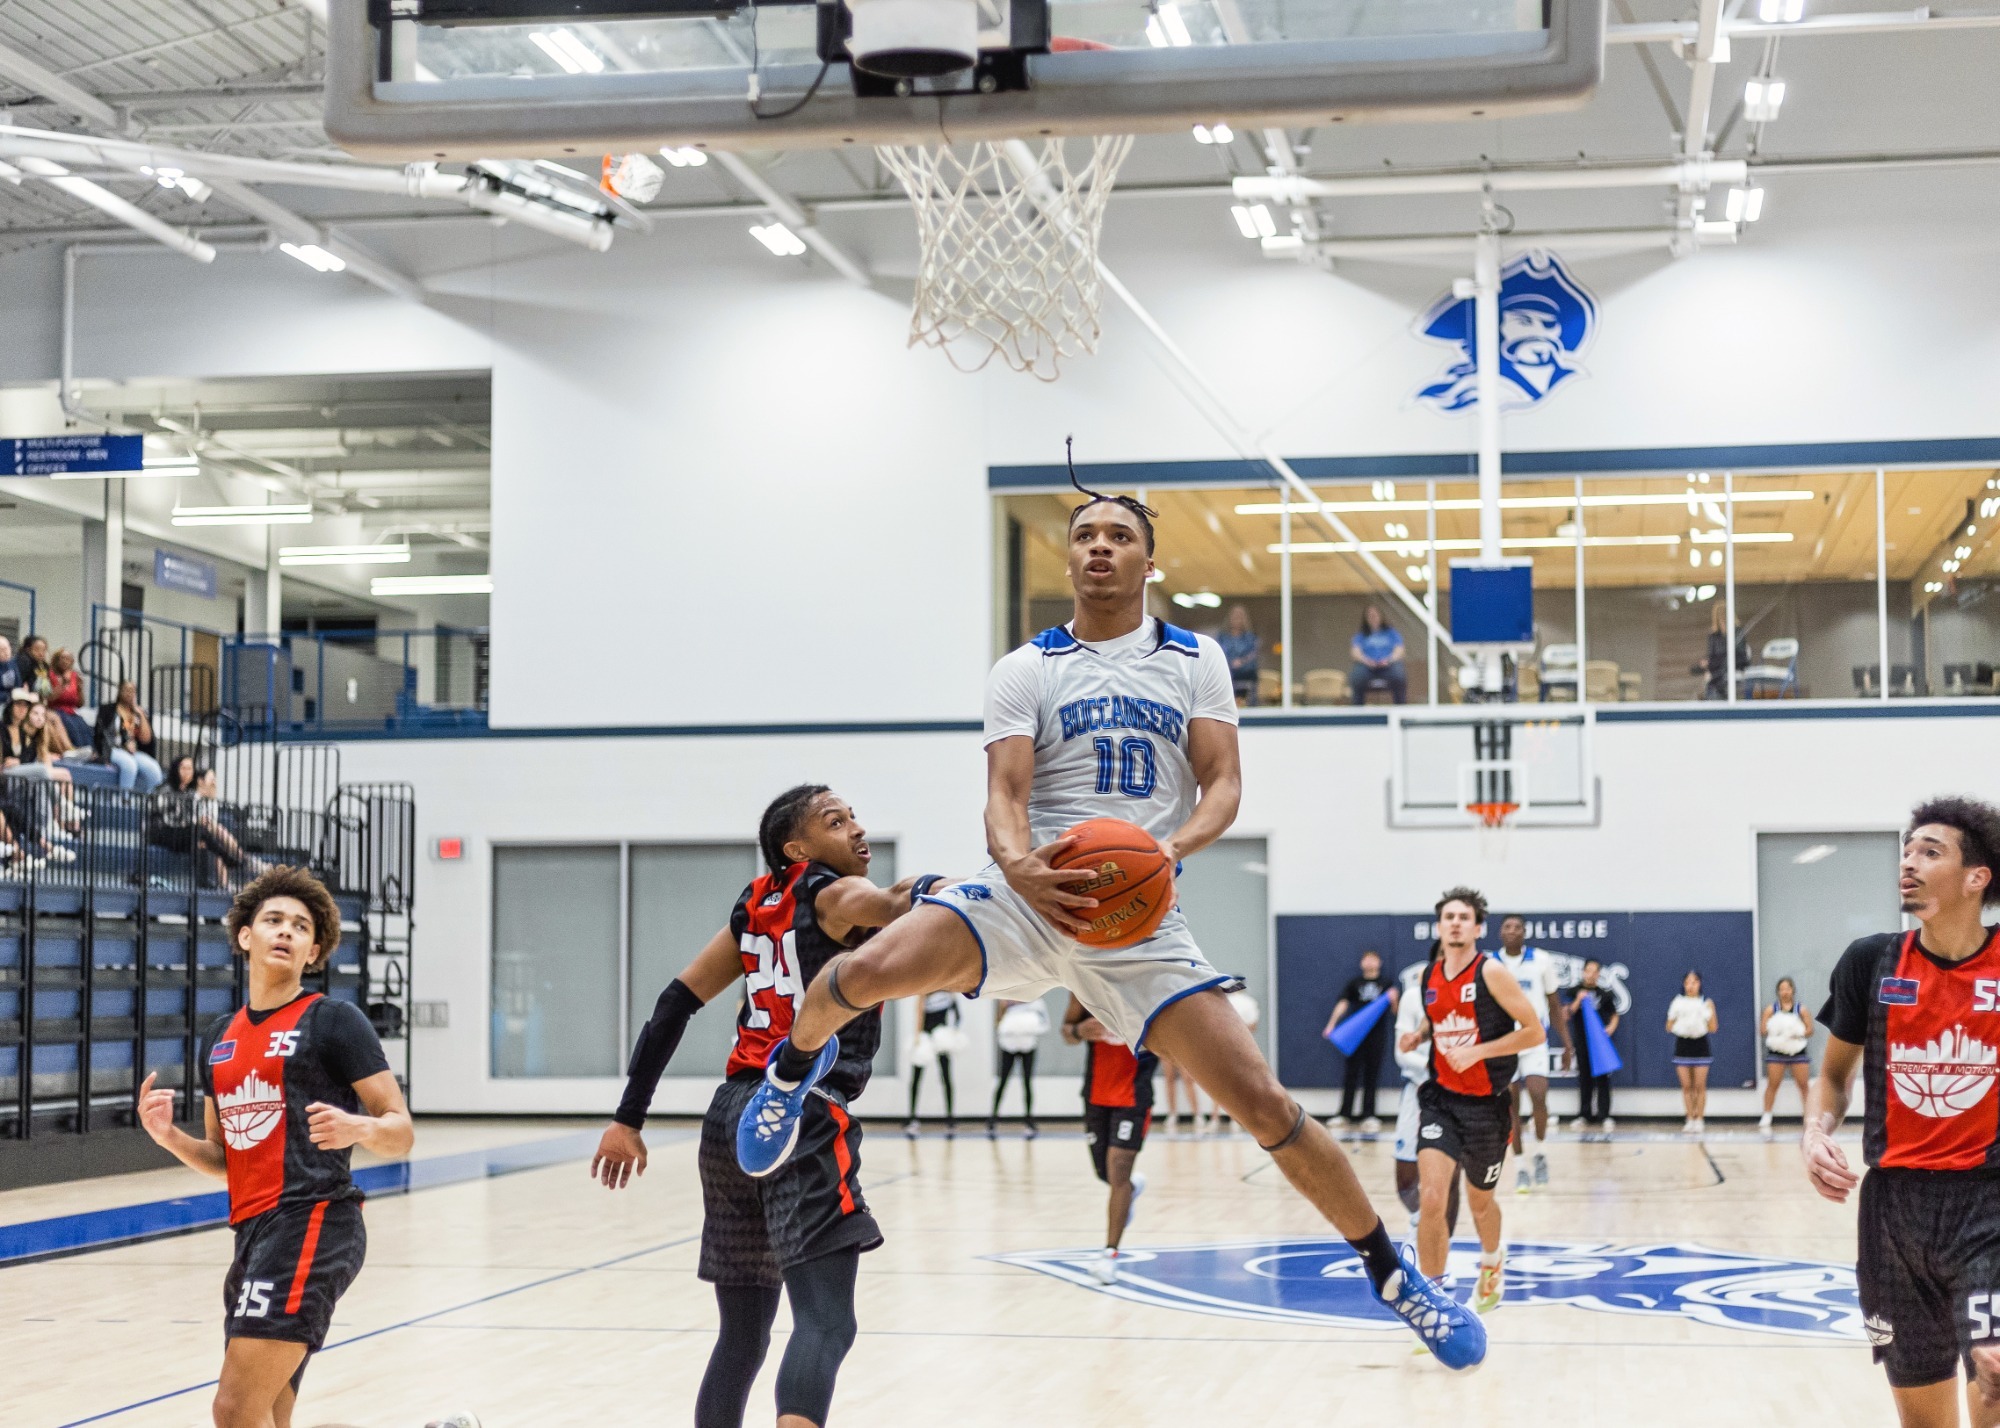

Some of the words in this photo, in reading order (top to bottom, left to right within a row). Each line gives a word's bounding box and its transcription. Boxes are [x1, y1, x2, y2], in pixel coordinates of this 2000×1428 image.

[1059, 694, 1185, 746] BUCCANEERS
[1092, 735, 1157, 799] 10
[1523, 919, 1609, 940] OLLEGE
[740, 929, 805, 1029] 24
[1973, 979, 2000, 1011] 5
[264, 1030, 301, 1058] 35
[1890, 1063, 1939, 1074] STRENGTH
[1943, 1065, 1952, 1074] N
[1954, 1065, 1995, 1075] MOTION
[251, 1102, 282, 1112] MOTION
[233, 1281, 275, 1318] 35
